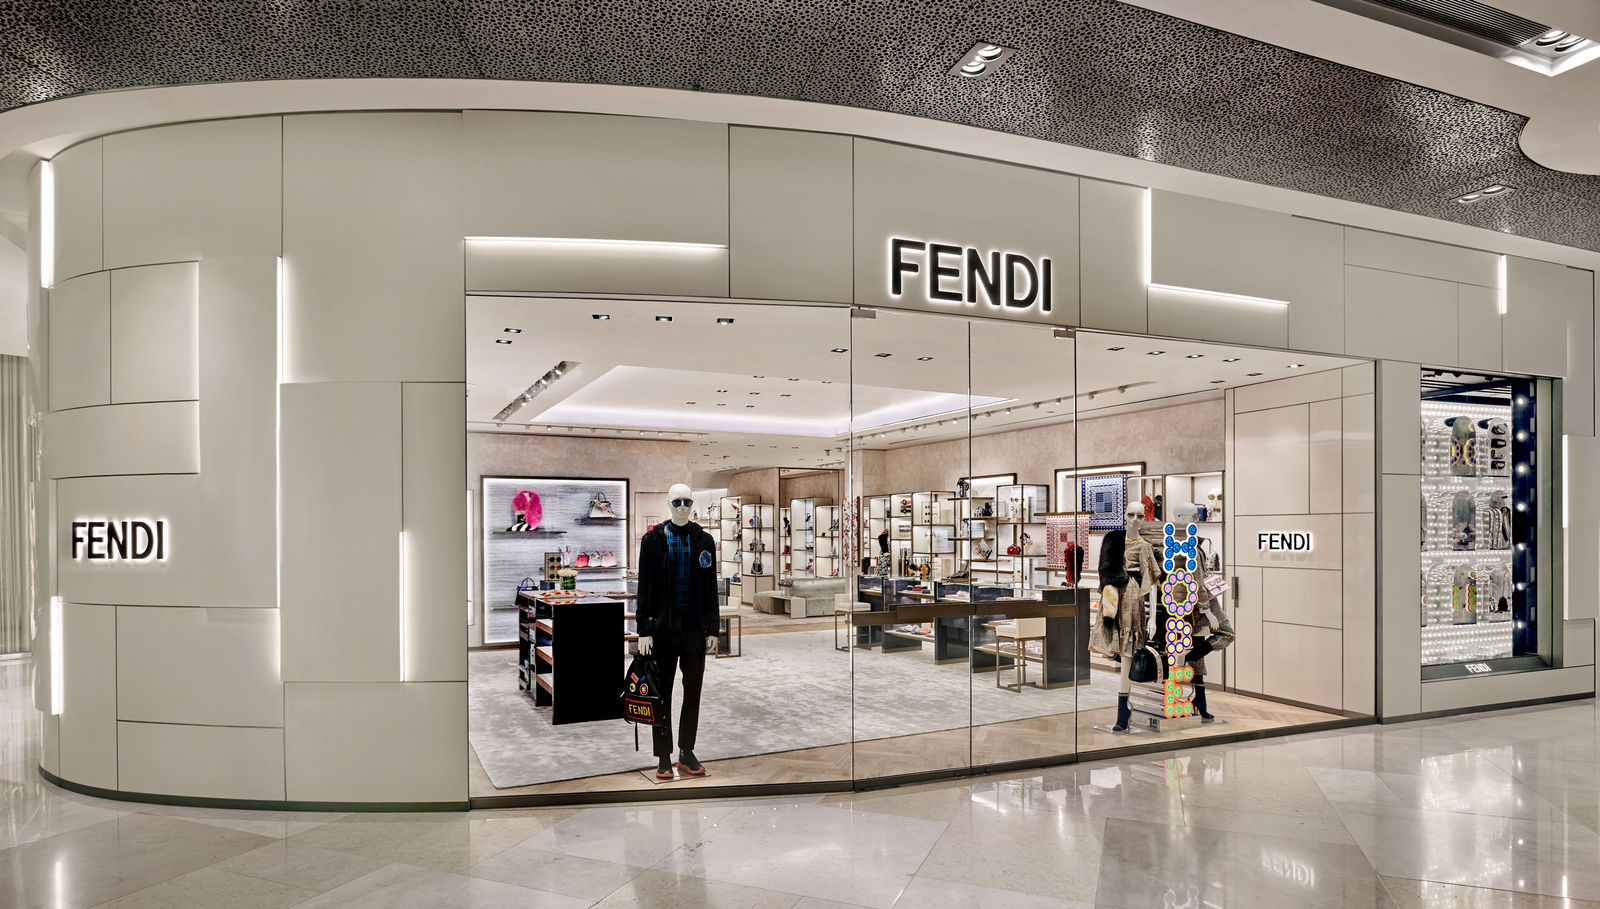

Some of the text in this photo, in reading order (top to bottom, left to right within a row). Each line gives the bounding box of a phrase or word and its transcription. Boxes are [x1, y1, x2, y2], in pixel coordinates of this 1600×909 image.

[891, 238, 1052, 311] FENDI
[71, 520, 164, 560] FENDI
[1258, 533, 1310, 551] FENDI
[1464, 662, 1492, 673] FENDI
[628, 703, 651, 717] FENDI
